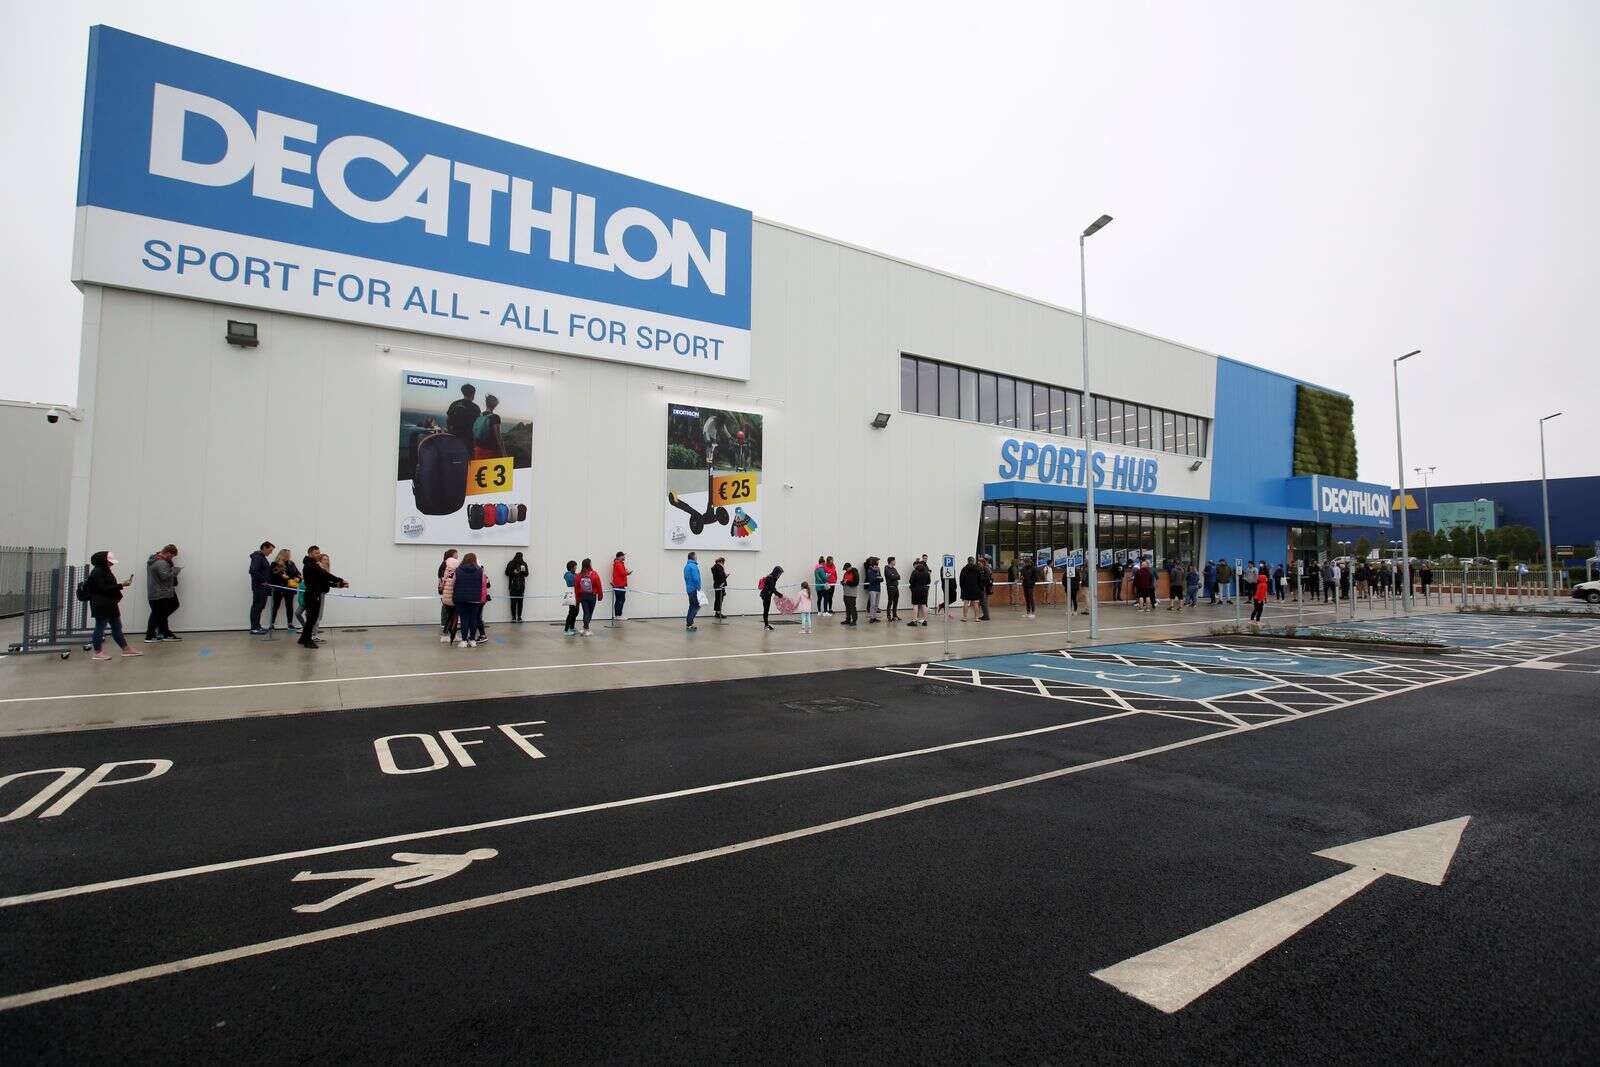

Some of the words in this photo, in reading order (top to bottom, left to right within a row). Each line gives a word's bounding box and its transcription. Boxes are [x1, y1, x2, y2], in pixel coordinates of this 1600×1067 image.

[149, 82, 727, 296] DECATHLON
[142, 239, 299, 292] SPORT
[312, 269, 391, 308] FOR
[404, 287, 470, 321] ALL
[500, 303, 559, 336] ALL
[568, 315, 628, 346] FOR
[636, 326, 725, 361] SPORT
[409, 377, 446, 386] DECATHLON
[493, 464, 506, 487] 3
[999, 438, 1106, 489] SPORTS
[1111, 453, 1159, 493] HUB
[731, 478, 750, 499] 25
[1321, 486, 1390, 518] DECATHLON
[374, 720, 548, 775] OFF
